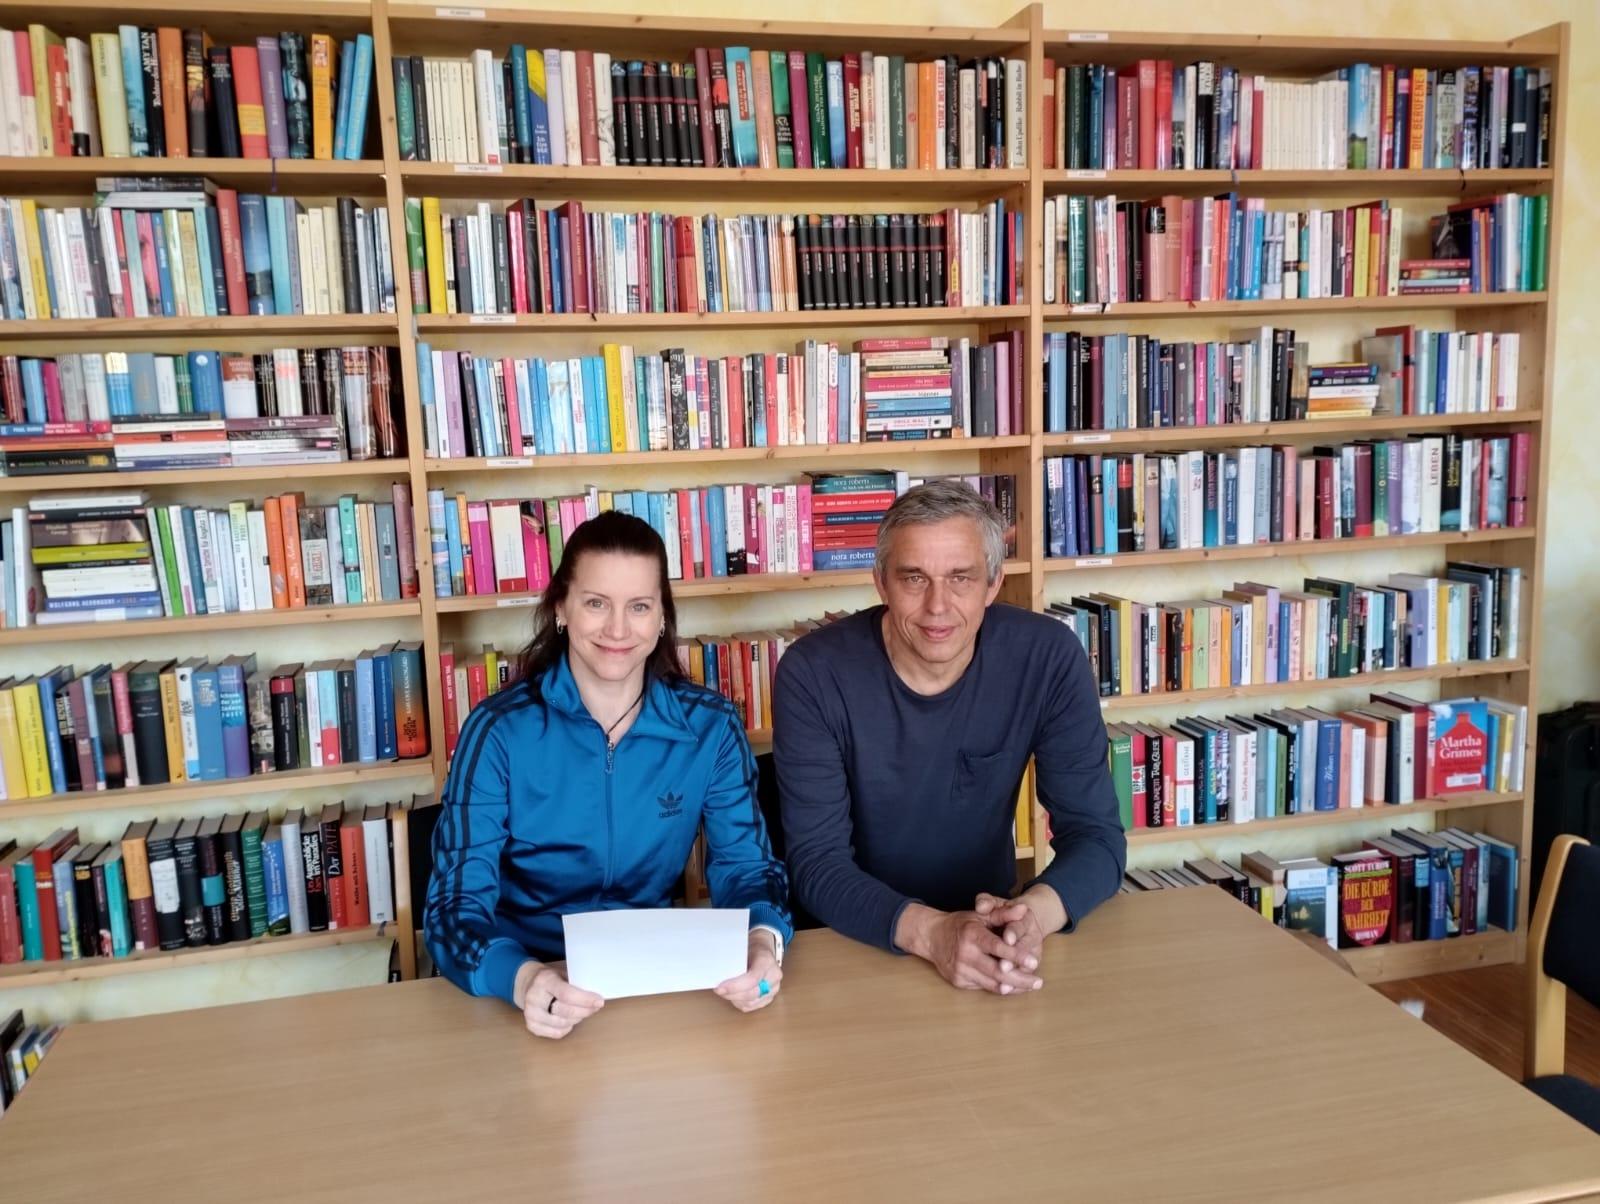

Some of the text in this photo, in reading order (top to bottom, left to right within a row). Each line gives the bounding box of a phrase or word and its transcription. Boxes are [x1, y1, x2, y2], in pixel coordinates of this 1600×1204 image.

[141, 32, 151, 73] AMY TAN
[937, 66, 945, 88] LEERE
[937, 90, 945, 103] INS
[1015, 91, 1023, 113] Rabbit
[1015, 118, 1024, 140] Updike
[1015, 141, 1023, 157] John
[1412, 134, 1422, 151] DIE
[1430, 447, 1439, 486] LEBEN
[801, 519, 809, 544] LIEBE
[850, 551, 876, 560] roberts
[49, 600, 80, 608] WOLFGANG
[1440, 735, 1481, 748] Martha
[1439, 748, 1481, 759] Grimes
[659, 808, 683, 818] adidas
[1152, 801, 1162, 825] SANDRA
[310, 834, 320, 865] Paradies
[326, 824, 338, 854] PATE
[303, 835, 313, 880] Augenblicke
[1343, 860, 1389, 873] SCOTT TUROW
[224, 851, 236, 895] Goldsmith
[1343, 878, 1389, 900] DIE BÜRDE
[1360, 899, 1373, 911] DER
[1343, 909, 1389, 931] WAHRHEIT
[1355, 929, 1378, 941] ROMAN
